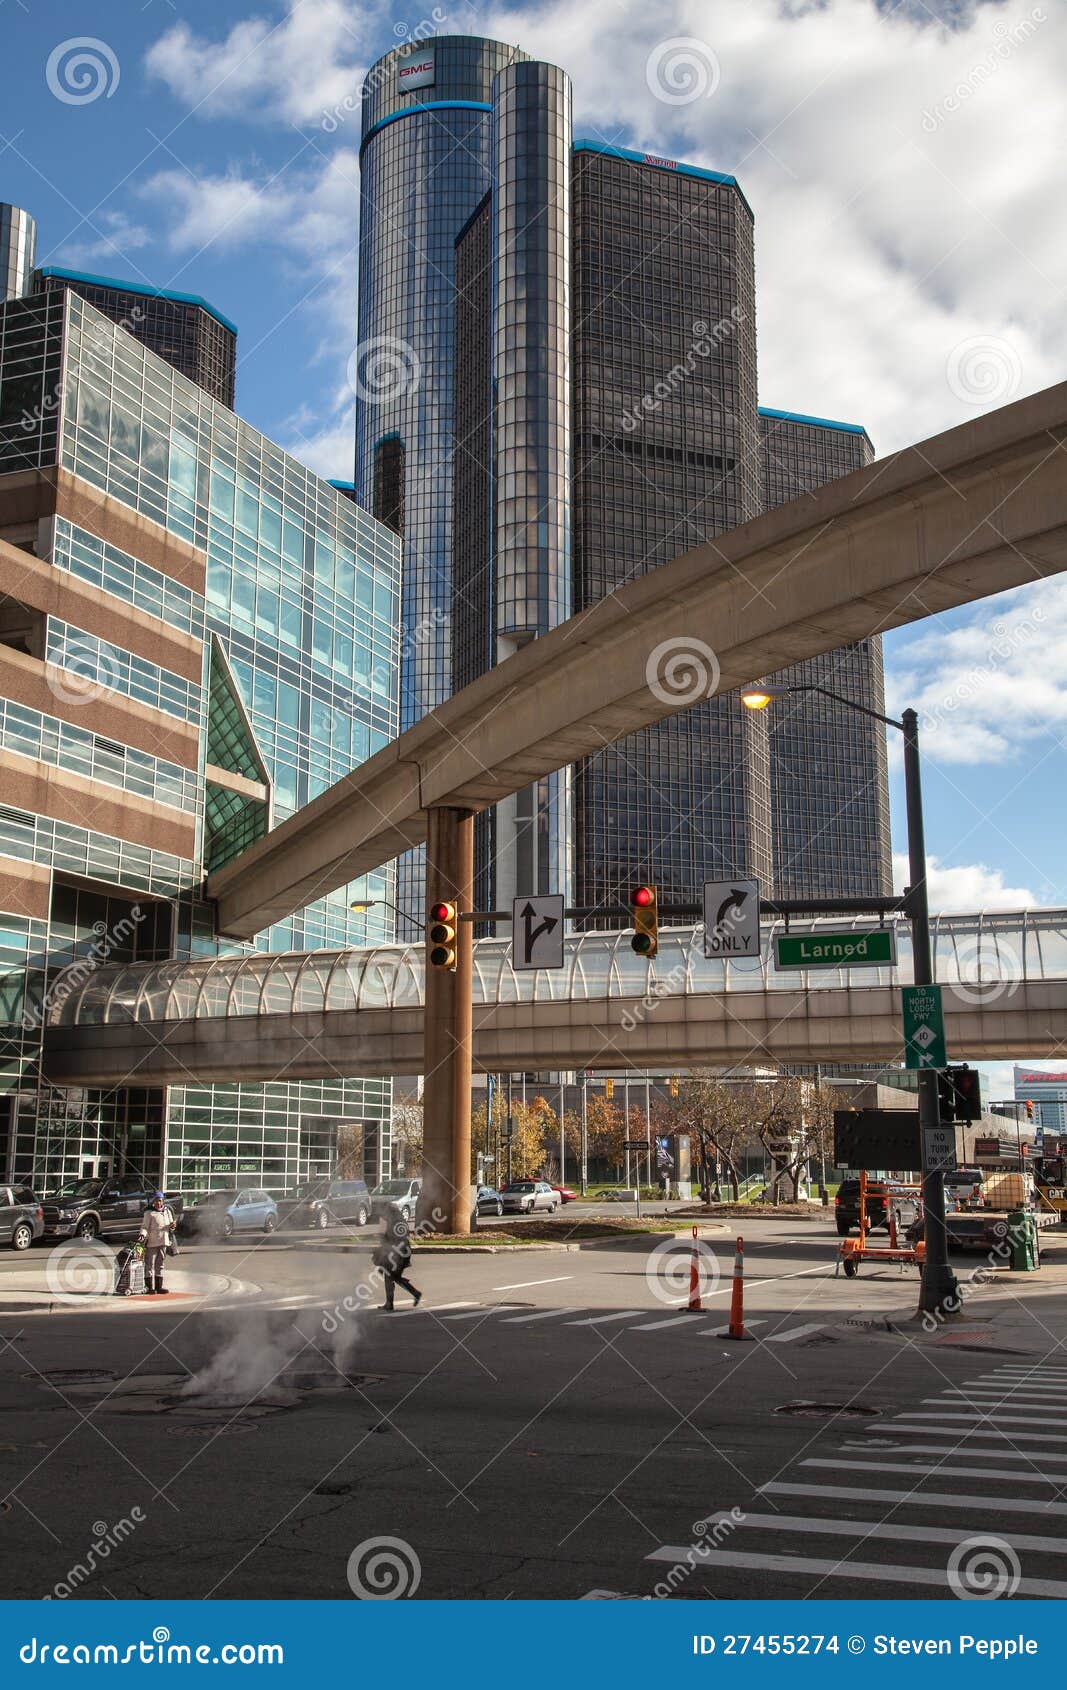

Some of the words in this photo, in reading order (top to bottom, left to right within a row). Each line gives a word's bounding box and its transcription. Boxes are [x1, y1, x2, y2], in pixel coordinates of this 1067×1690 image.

[399, 61, 433, 77] GMC
[644, 154, 677, 169] Marriott
[711, 935, 751, 952] ONLY
[801, 941, 868, 958] Larned
[916, 988, 926, 996] TO
[909, 997, 936, 1005] NORTH
[910, 1004, 936, 1013] LODGE
[920, 1031, 929, 1041] 10
[934, 1132, 945, 1142] NO
[931, 1144, 949, 1153] TURN
[928, 1156, 938, 1165] ON
[1048, 1189, 1065, 1199] CAT
